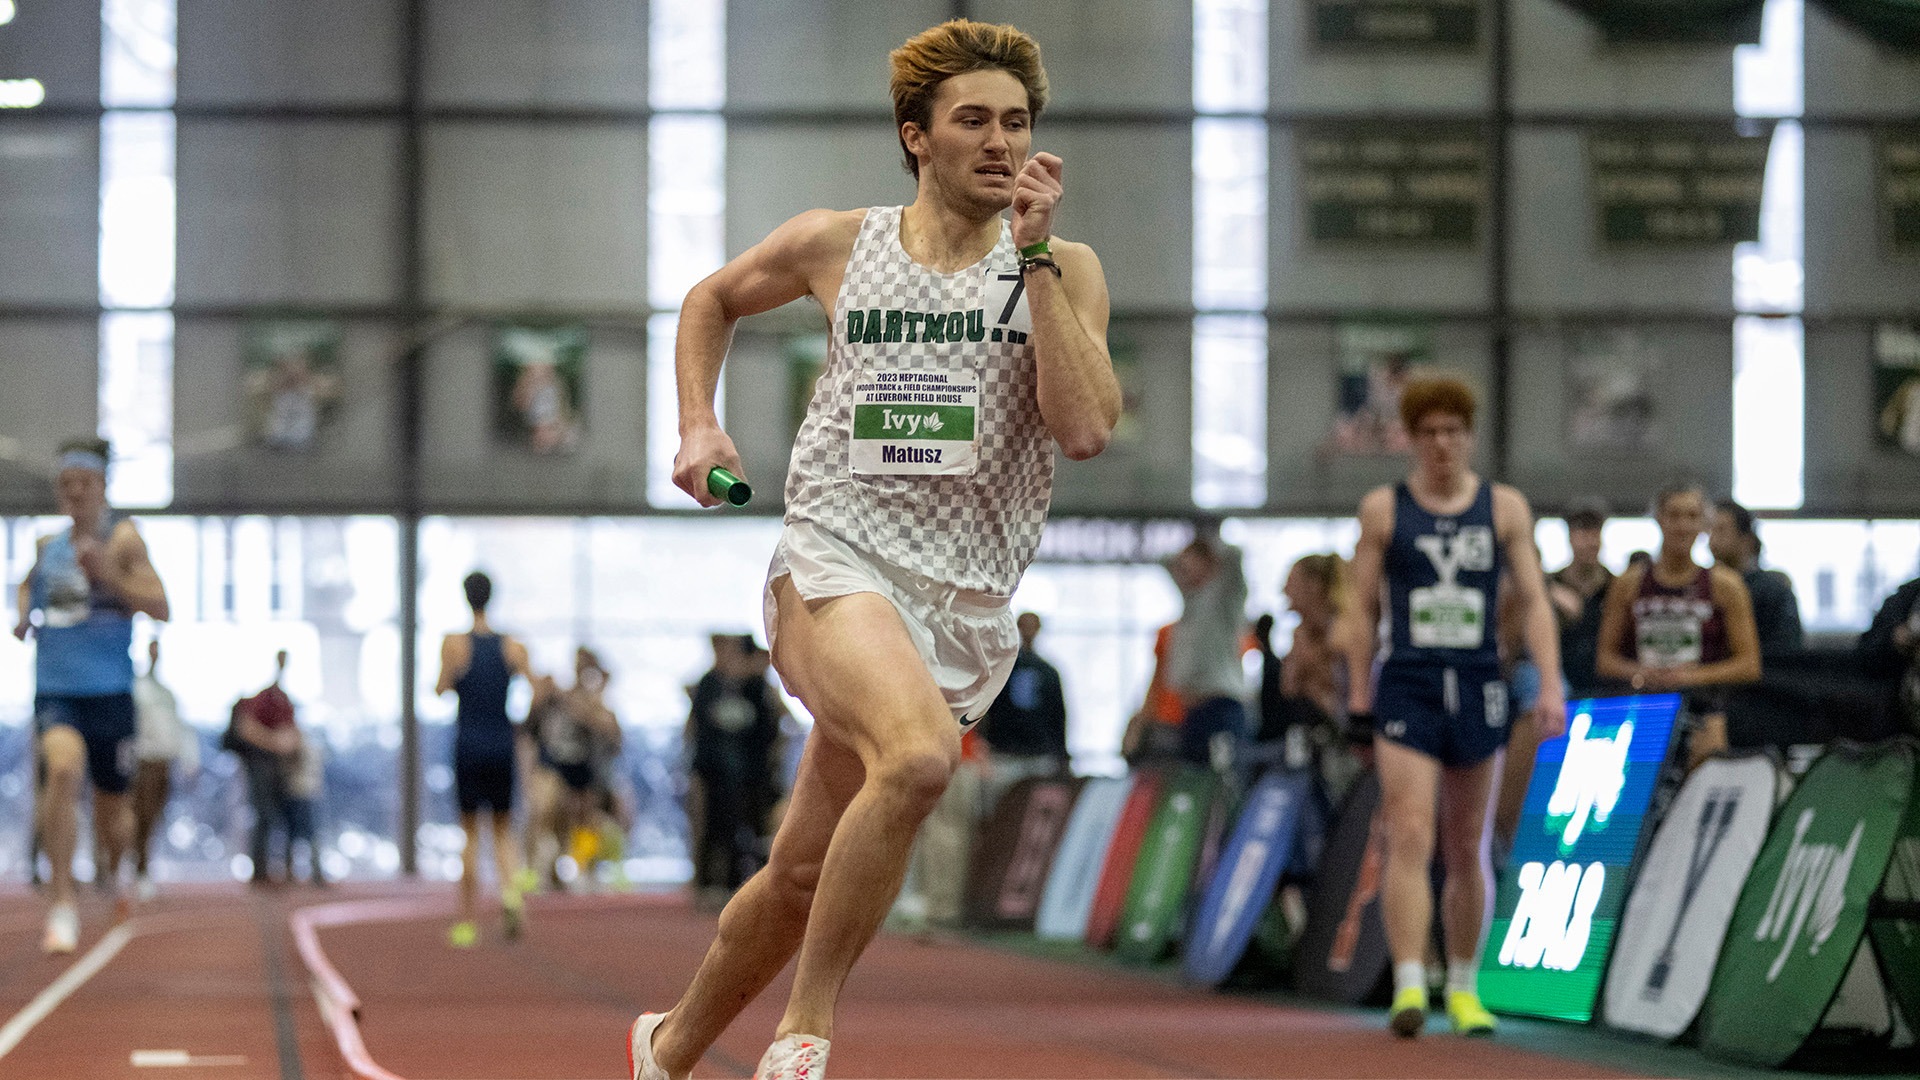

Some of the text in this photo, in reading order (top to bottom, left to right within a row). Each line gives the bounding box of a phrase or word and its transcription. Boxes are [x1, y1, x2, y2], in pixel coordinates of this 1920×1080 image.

[997, 274, 1026, 325] 7
[847, 309, 1028, 345] DARTMOU
[876, 373, 948, 383] 2023 HEPTAGONAL
[921, 384, 977, 393] CHAMPIONSHIPS
[866, 393, 962, 403] AT LEVERONE FIELD HOUSE
[882, 409, 922, 436] Ivy
[882, 445, 942, 464] Matusz
[1756, 808, 1839, 983] Ivy
